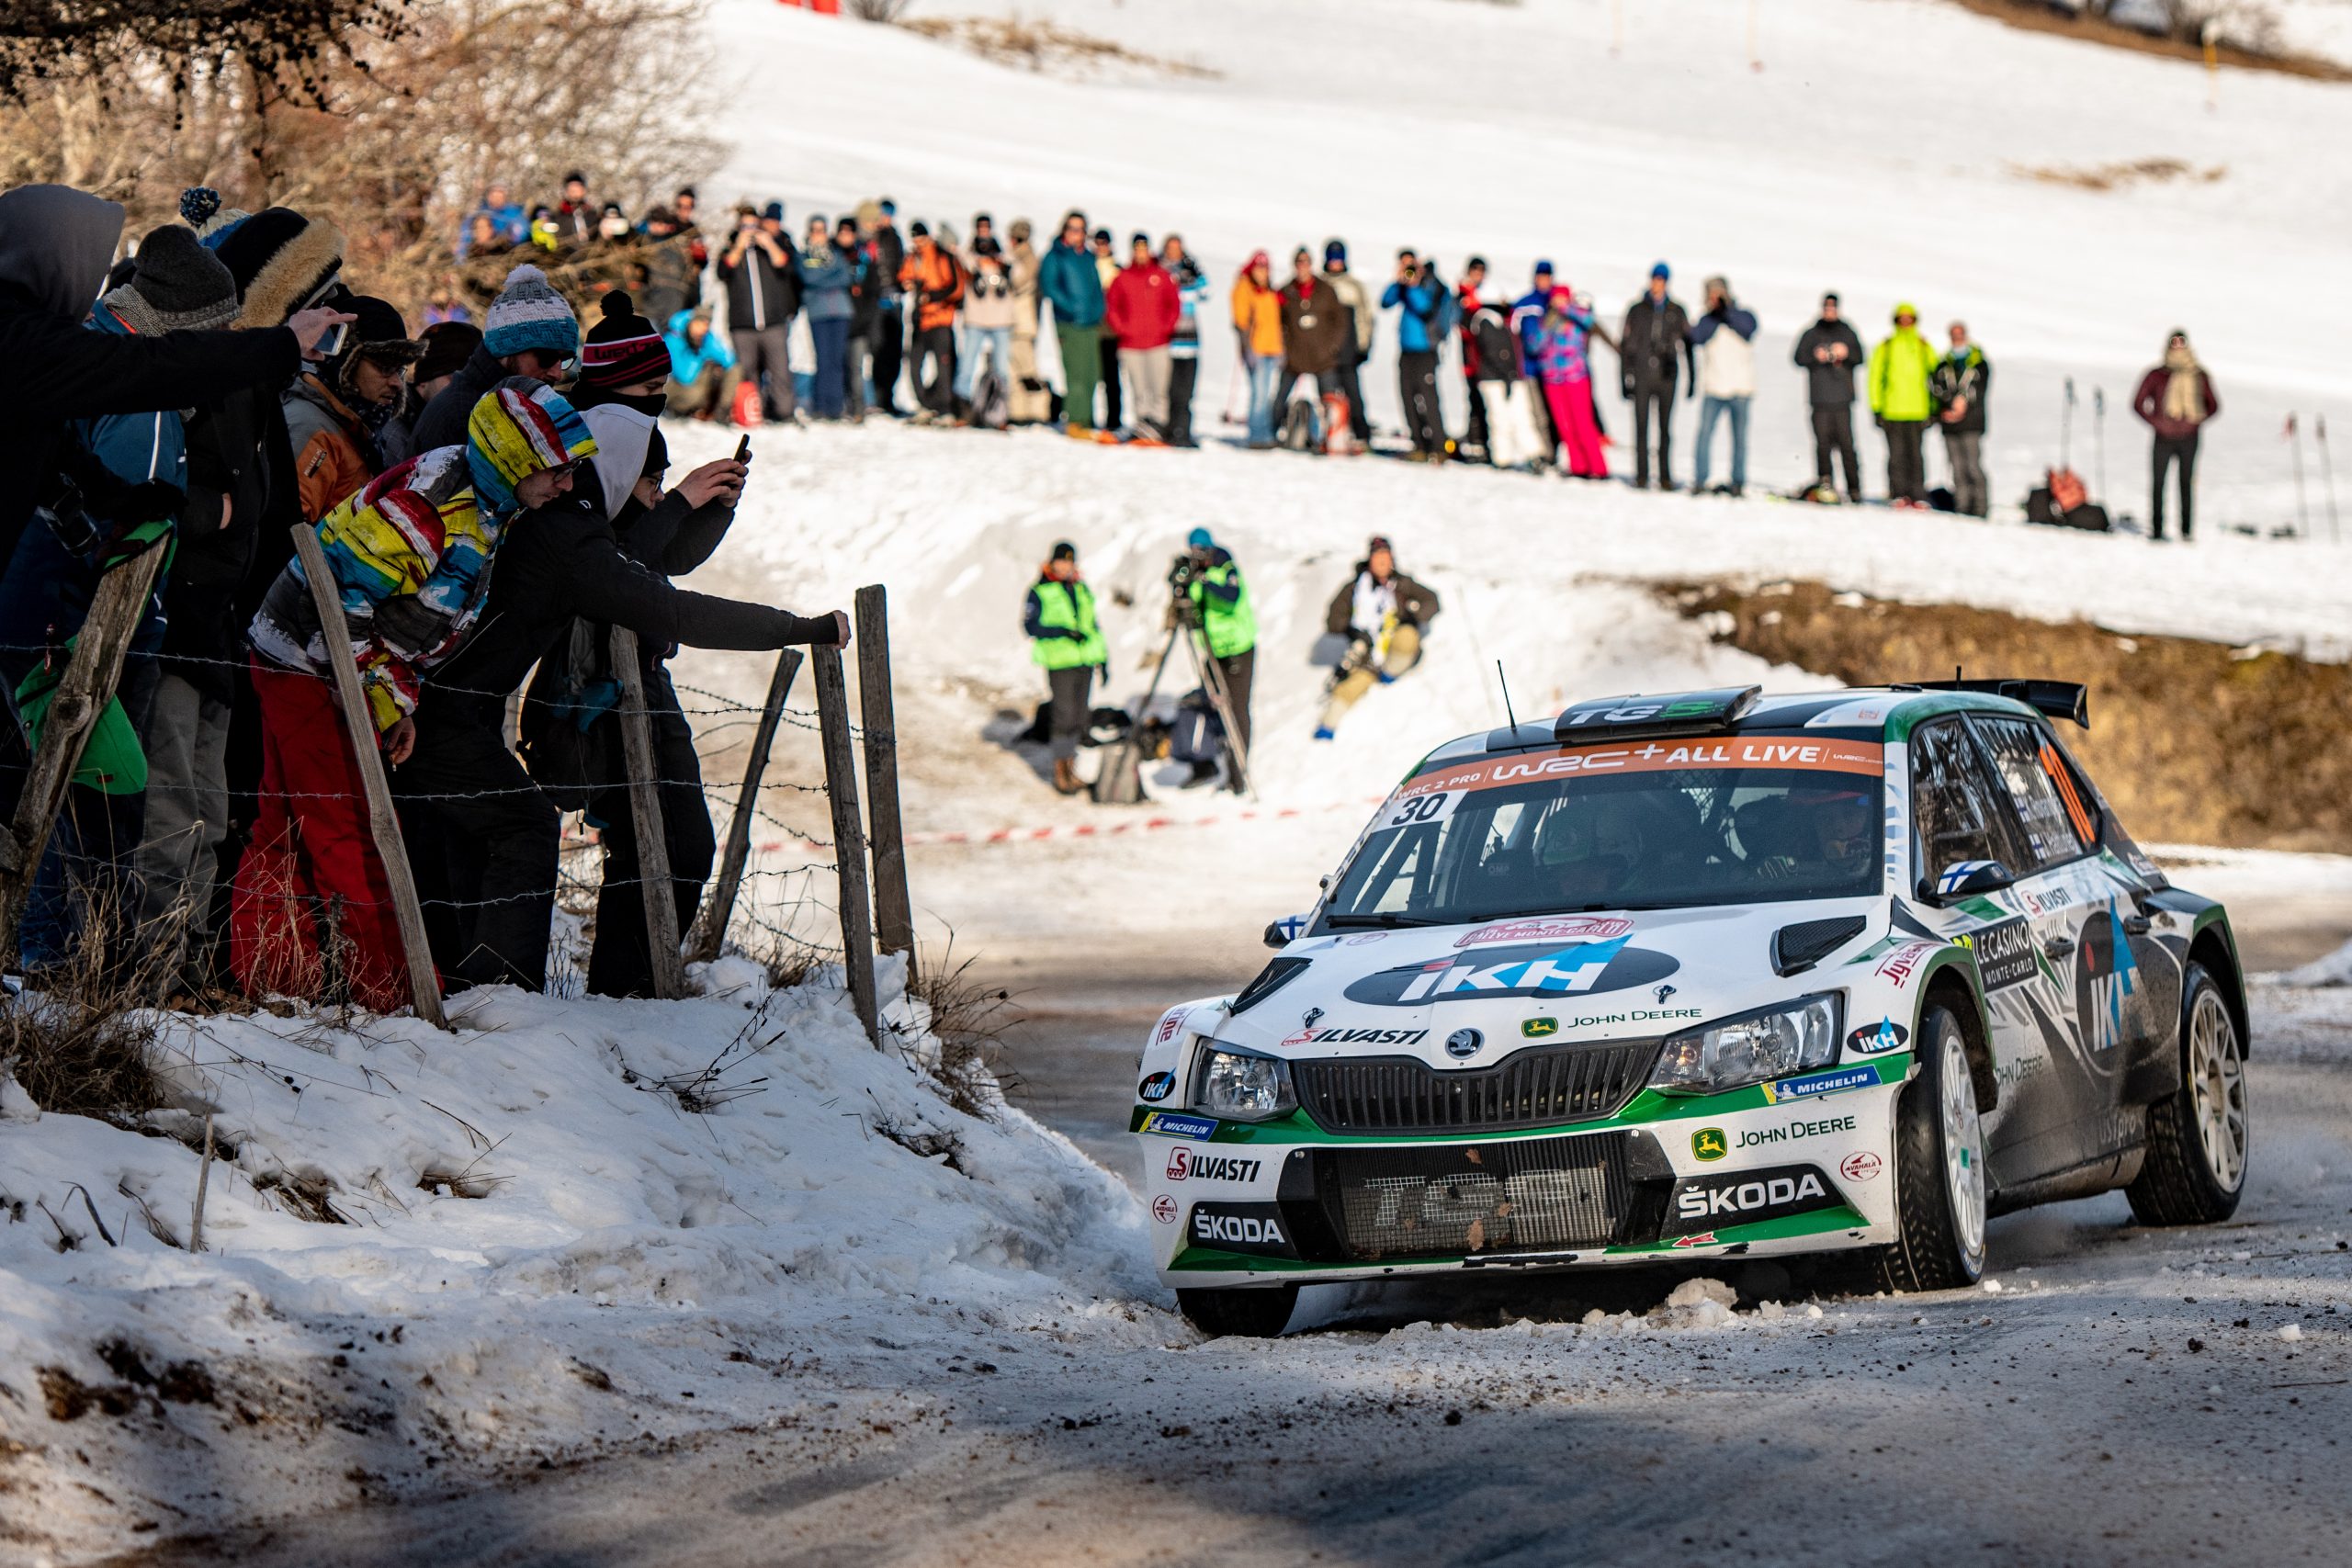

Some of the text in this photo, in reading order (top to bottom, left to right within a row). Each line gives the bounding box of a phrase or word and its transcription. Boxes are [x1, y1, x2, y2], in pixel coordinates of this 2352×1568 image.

[1397, 784, 1430, 798] WRC
[1435, 781, 1444, 789] 2
[1449, 773, 1480, 785] PRO
[1666, 746, 1731, 763] ALL
[1742, 745, 1821, 762] LIVE
[1391, 793, 1448, 826] 30
[1976, 937, 1989, 964] LE
[1990, 921, 2030, 961] CASINO
[1567, 1009, 1702, 1028] JOHN DEERE
[1297, 1028, 1430, 1045] SILVASTI
[1797, 1073, 1868, 1094] MICHELIN
[1996, 1065, 2014, 1086] OHN
[1163, 1122, 1209, 1134] MICHELIN
[1736, 1116, 1856, 1148] JOHN DEERE
[1173, 1151, 1261, 1182] SILVASTI
[1678, 1174, 1826, 1219] ŠKODA
[1195, 1209, 1285, 1244] ŠKODA
